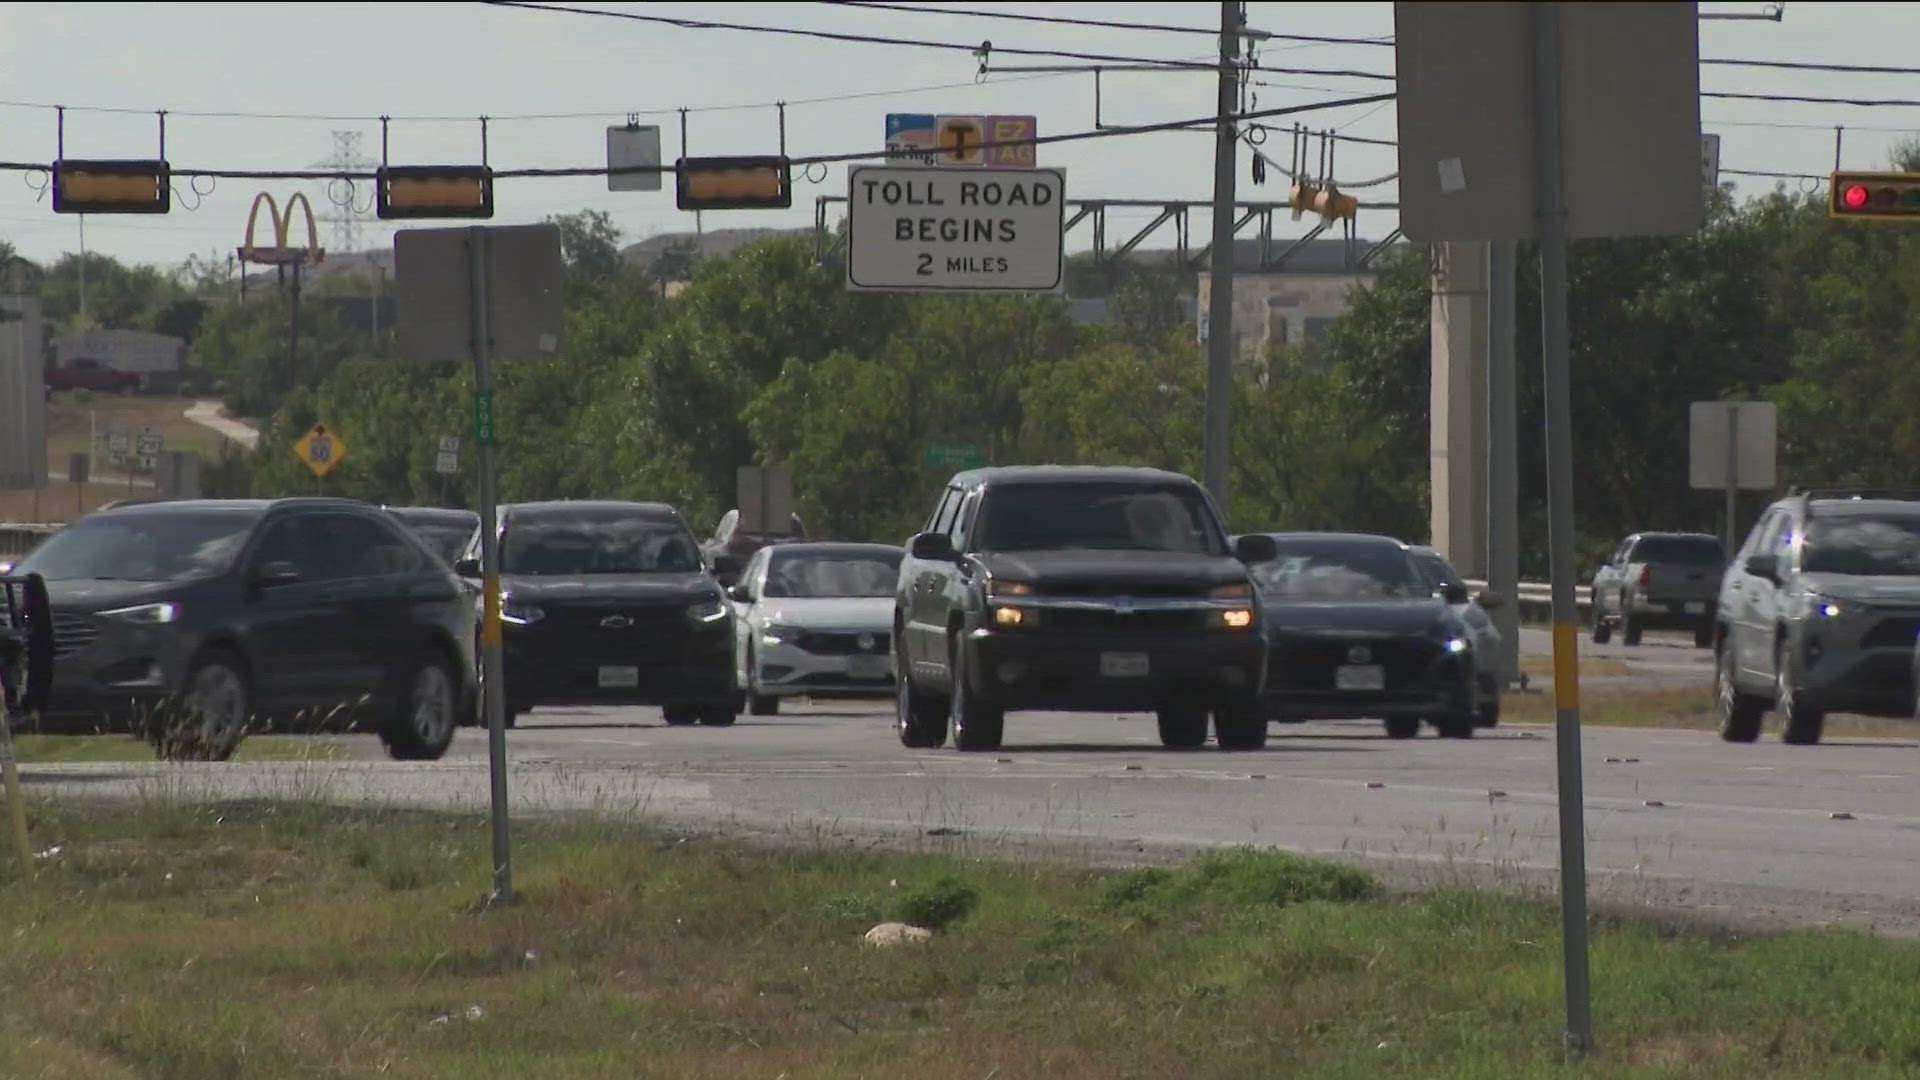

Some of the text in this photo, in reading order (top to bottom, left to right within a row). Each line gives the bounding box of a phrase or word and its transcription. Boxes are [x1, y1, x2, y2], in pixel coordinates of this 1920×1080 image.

[947, 124, 975, 160] T
[995, 121, 1028, 142] EZ
[862, 180, 1052, 207] TOLL ROAD
[895, 218, 1016, 243] BEGINS
[916, 252, 1008, 276] 2 MILES
